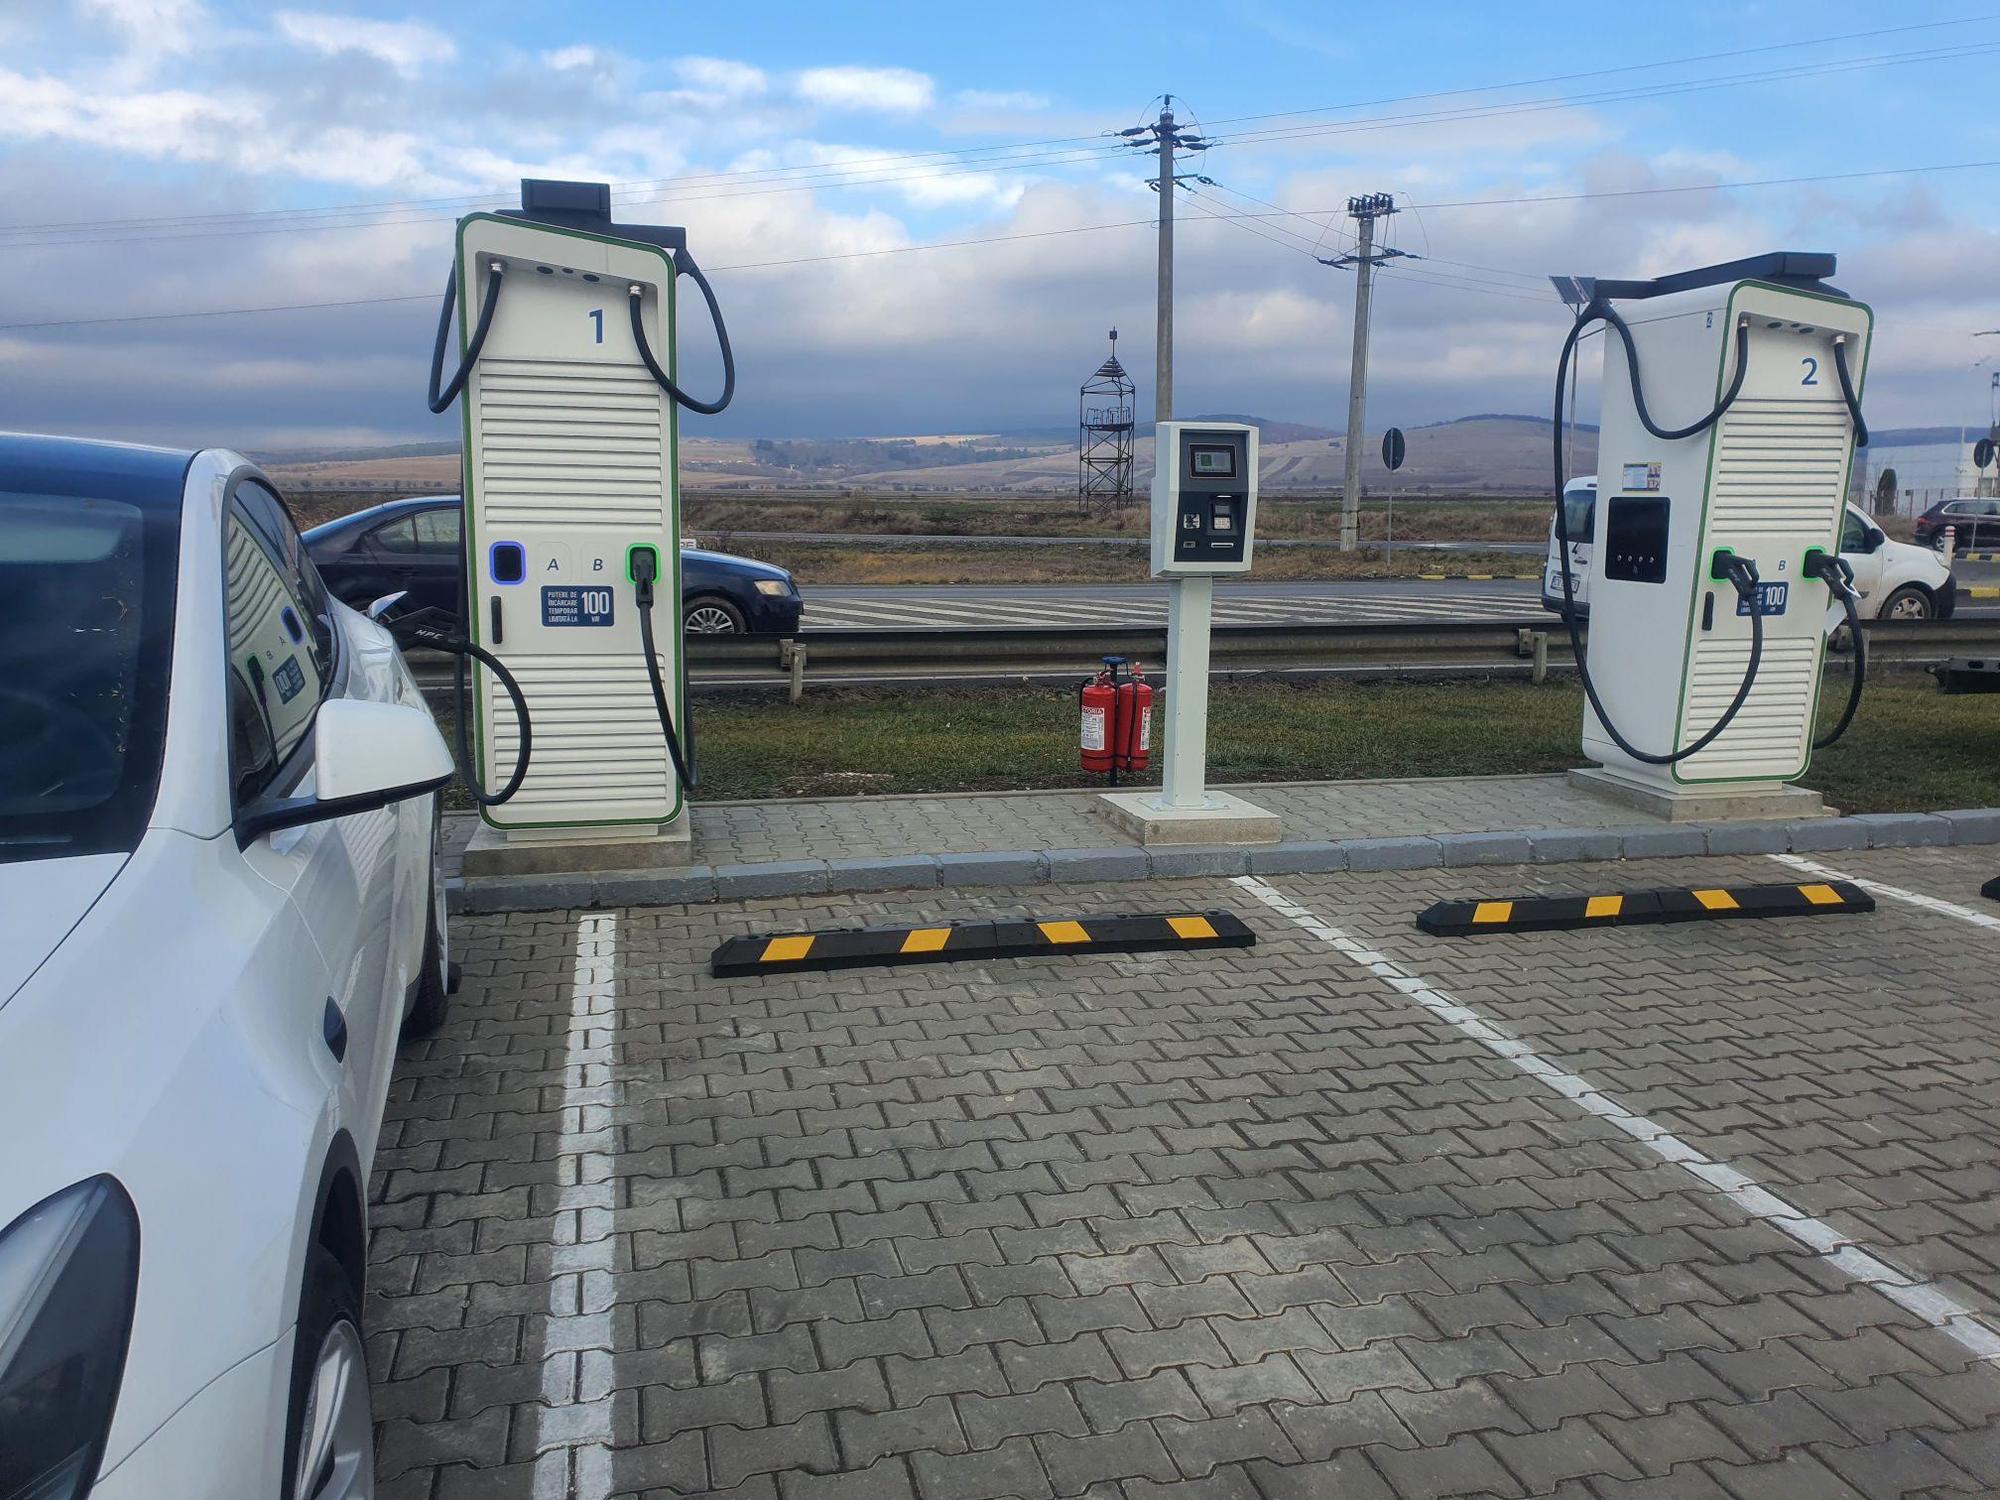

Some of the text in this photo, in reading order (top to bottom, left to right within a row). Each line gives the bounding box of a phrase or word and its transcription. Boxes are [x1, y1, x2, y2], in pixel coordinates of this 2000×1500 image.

[589, 309, 603, 344] 1
[1801, 357, 1818, 385] 2
[546, 558, 559, 571] A
[593, 558, 603, 571] B
[1778, 559, 1787, 571] B
[581, 591, 610, 614] 100
[1765, 586, 1786, 606] 100
[548, 607, 578, 615] TEMPORAR
[414, 629, 444, 640] HPC
